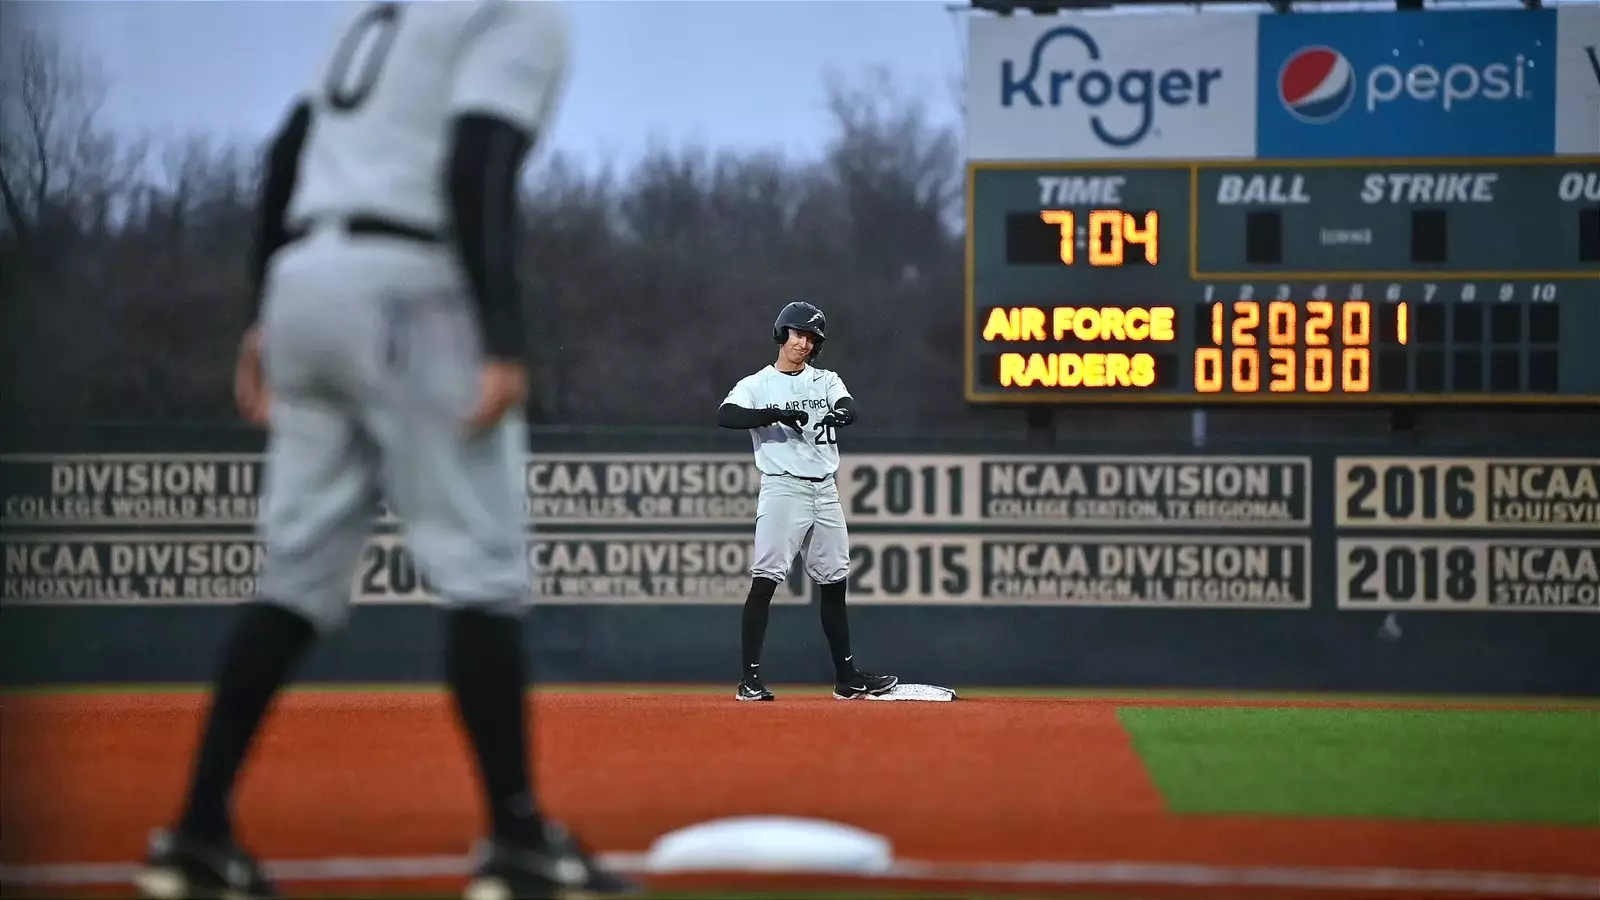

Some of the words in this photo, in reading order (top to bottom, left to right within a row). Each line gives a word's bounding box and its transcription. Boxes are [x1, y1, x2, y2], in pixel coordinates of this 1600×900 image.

[1001, 25, 1223, 148] Kroger
[1366, 54, 1526, 113] pepsi
[1037, 176, 1126, 205] TIME
[1217, 174, 1311, 204] BALL
[1361, 173, 1498, 203] STRIKE
[1532, 284, 1557, 302] 10
[983, 307, 1046, 341] AIR
[1053, 307, 1174, 341] FORCE
[1000, 353, 1155, 387] RAIDERS
[785, 400, 800, 410] AIR
[53, 464, 216, 494] DIVISION
[229, 464, 254, 494] II
[851, 465, 964, 516] 2011
[991, 465, 1088, 496] NCAA
[1098, 465, 1268, 496] DIVISION
[1283, 465, 1292, 496] I
[1347, 465, 1475, 519] 2016
[1494, 467, 1598, 499] NCAA
[7, 498, 104, 518] COLLEGE
[112, 498, 196, 518] WORLD
[990, 499, 1068, 518] COLLEGE
[1167, 499, 1190, 518] TX
[1195, 499, 1291, 518] REGIONAL
[5, 543, 101, 574] NCAA
[361, 544, 438, 594] 20
[848, 544, 969, 595] 2015
[991, 544, 1089, 576] NCAA
[1099, 545, 1268, 577] DIVISION
[1282, 546, 1292, 577] I
[1348, 545, 1476, 602] 2018
[1495, 547, 1599, 580] NCAA
[146, 577, 176, 598] TN
[683, 577, 753, 597] REGIO
[1174, 579, 1295, 600] REGIONAL
[1496, 583, 1600, 605] STANFO
